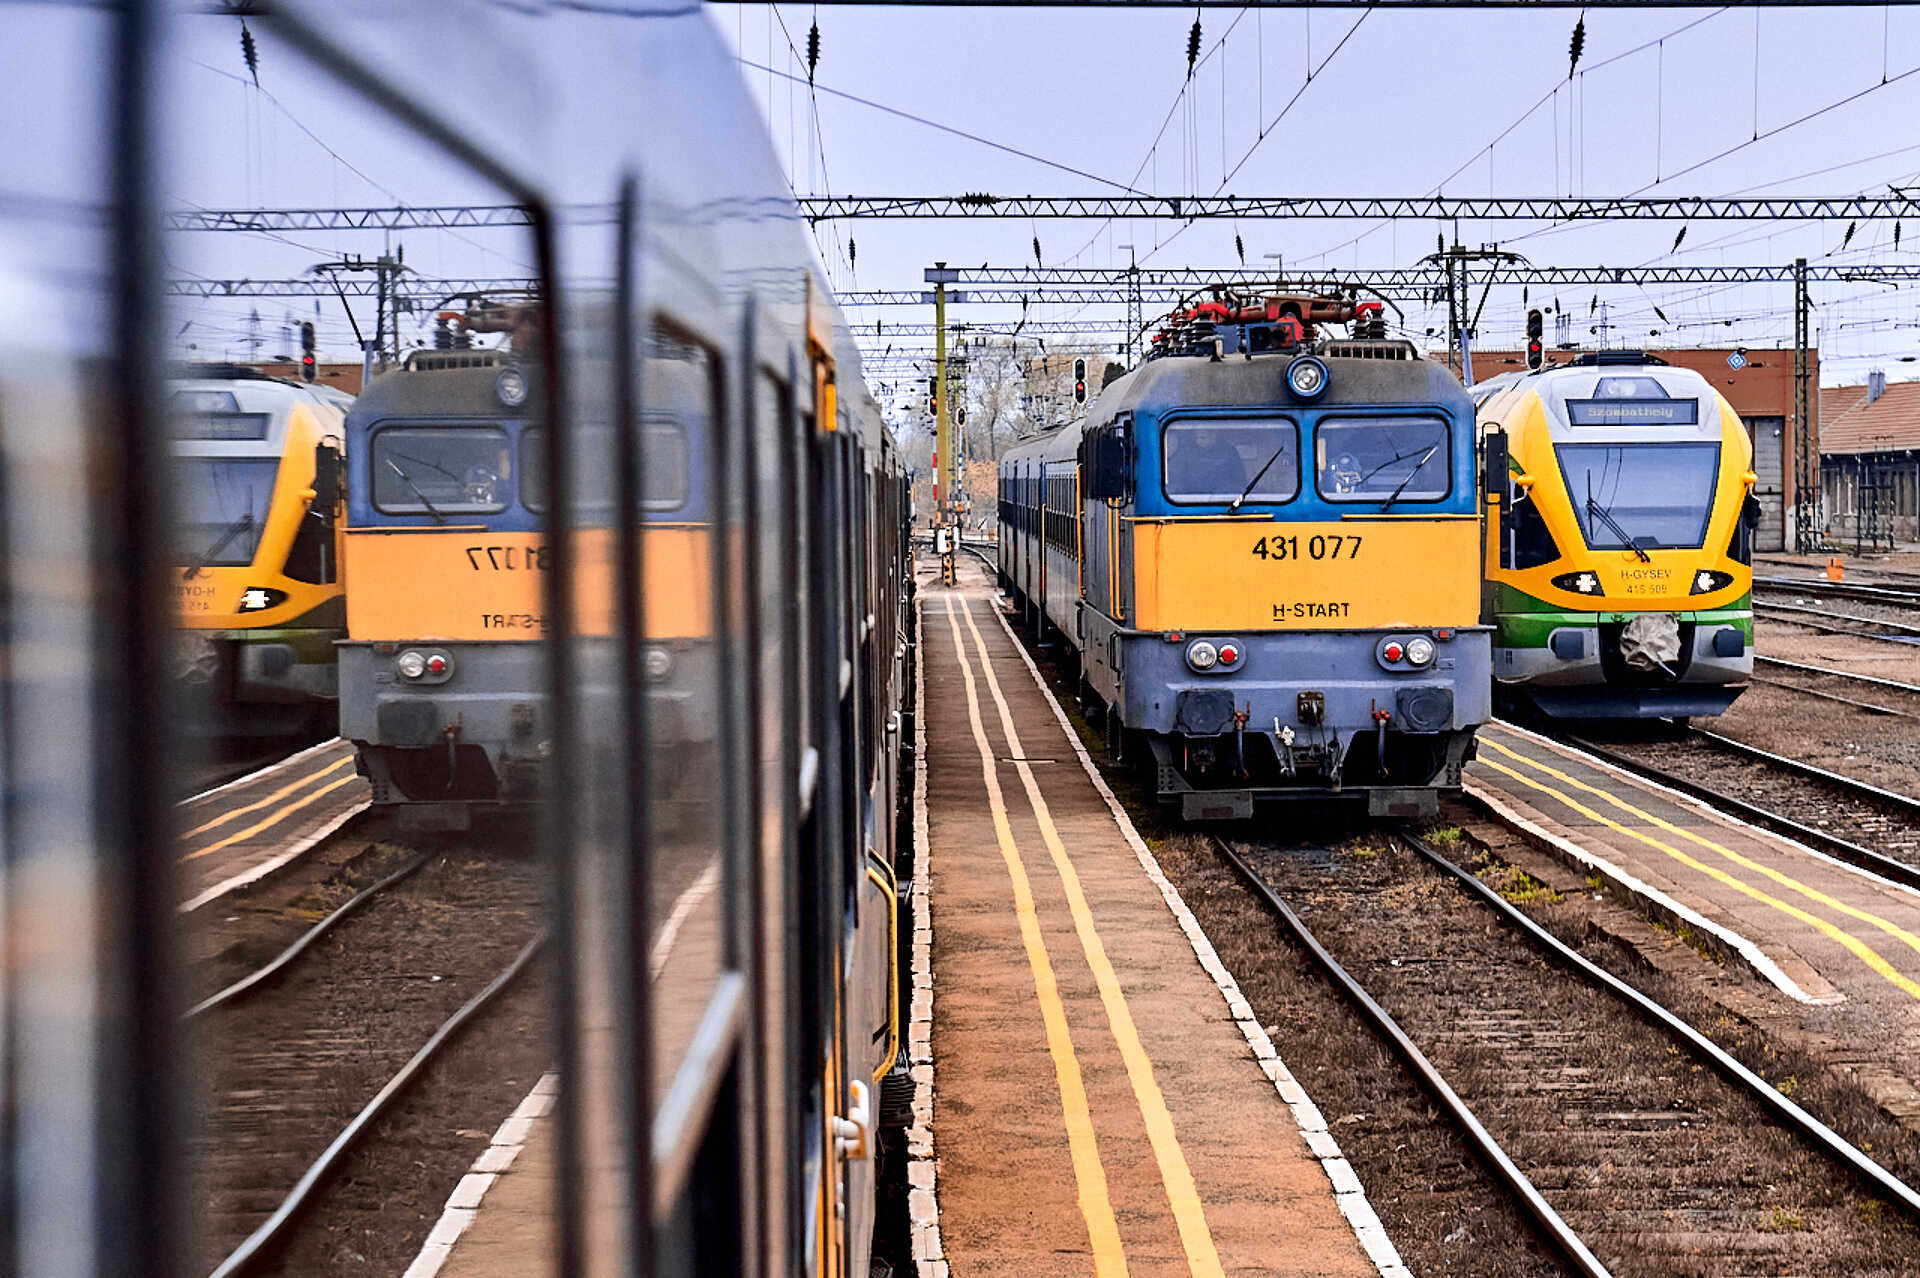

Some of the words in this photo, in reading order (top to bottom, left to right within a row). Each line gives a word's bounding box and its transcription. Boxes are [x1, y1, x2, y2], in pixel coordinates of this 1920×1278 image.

[1252, 535, 1298, 560] 431
[1309, 535, 1362, 560] 077
[1621, 569, 1672, 579] H-GYSEV
[1272, 602, 1350, 622] H-START
